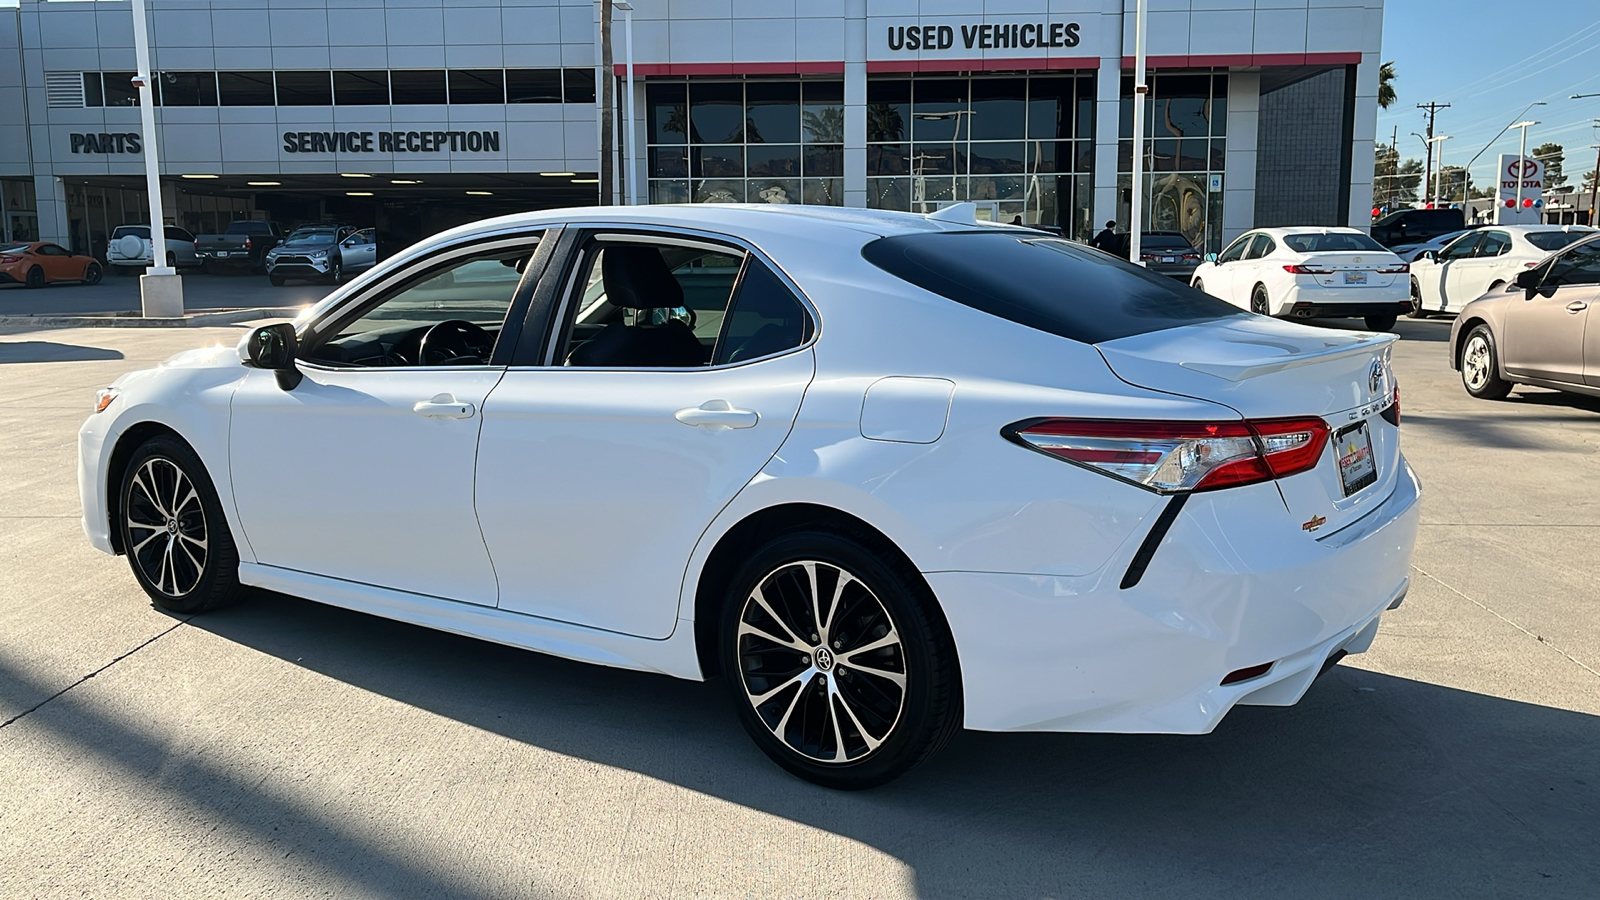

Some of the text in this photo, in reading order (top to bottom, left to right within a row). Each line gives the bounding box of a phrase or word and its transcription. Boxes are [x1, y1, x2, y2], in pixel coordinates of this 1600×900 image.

[888, 23, 1080, 50] USED VEHICLES
[70, 133, 141, 153] PARTS
[283, 131, 499, 152] SERVICE RECEPTION
